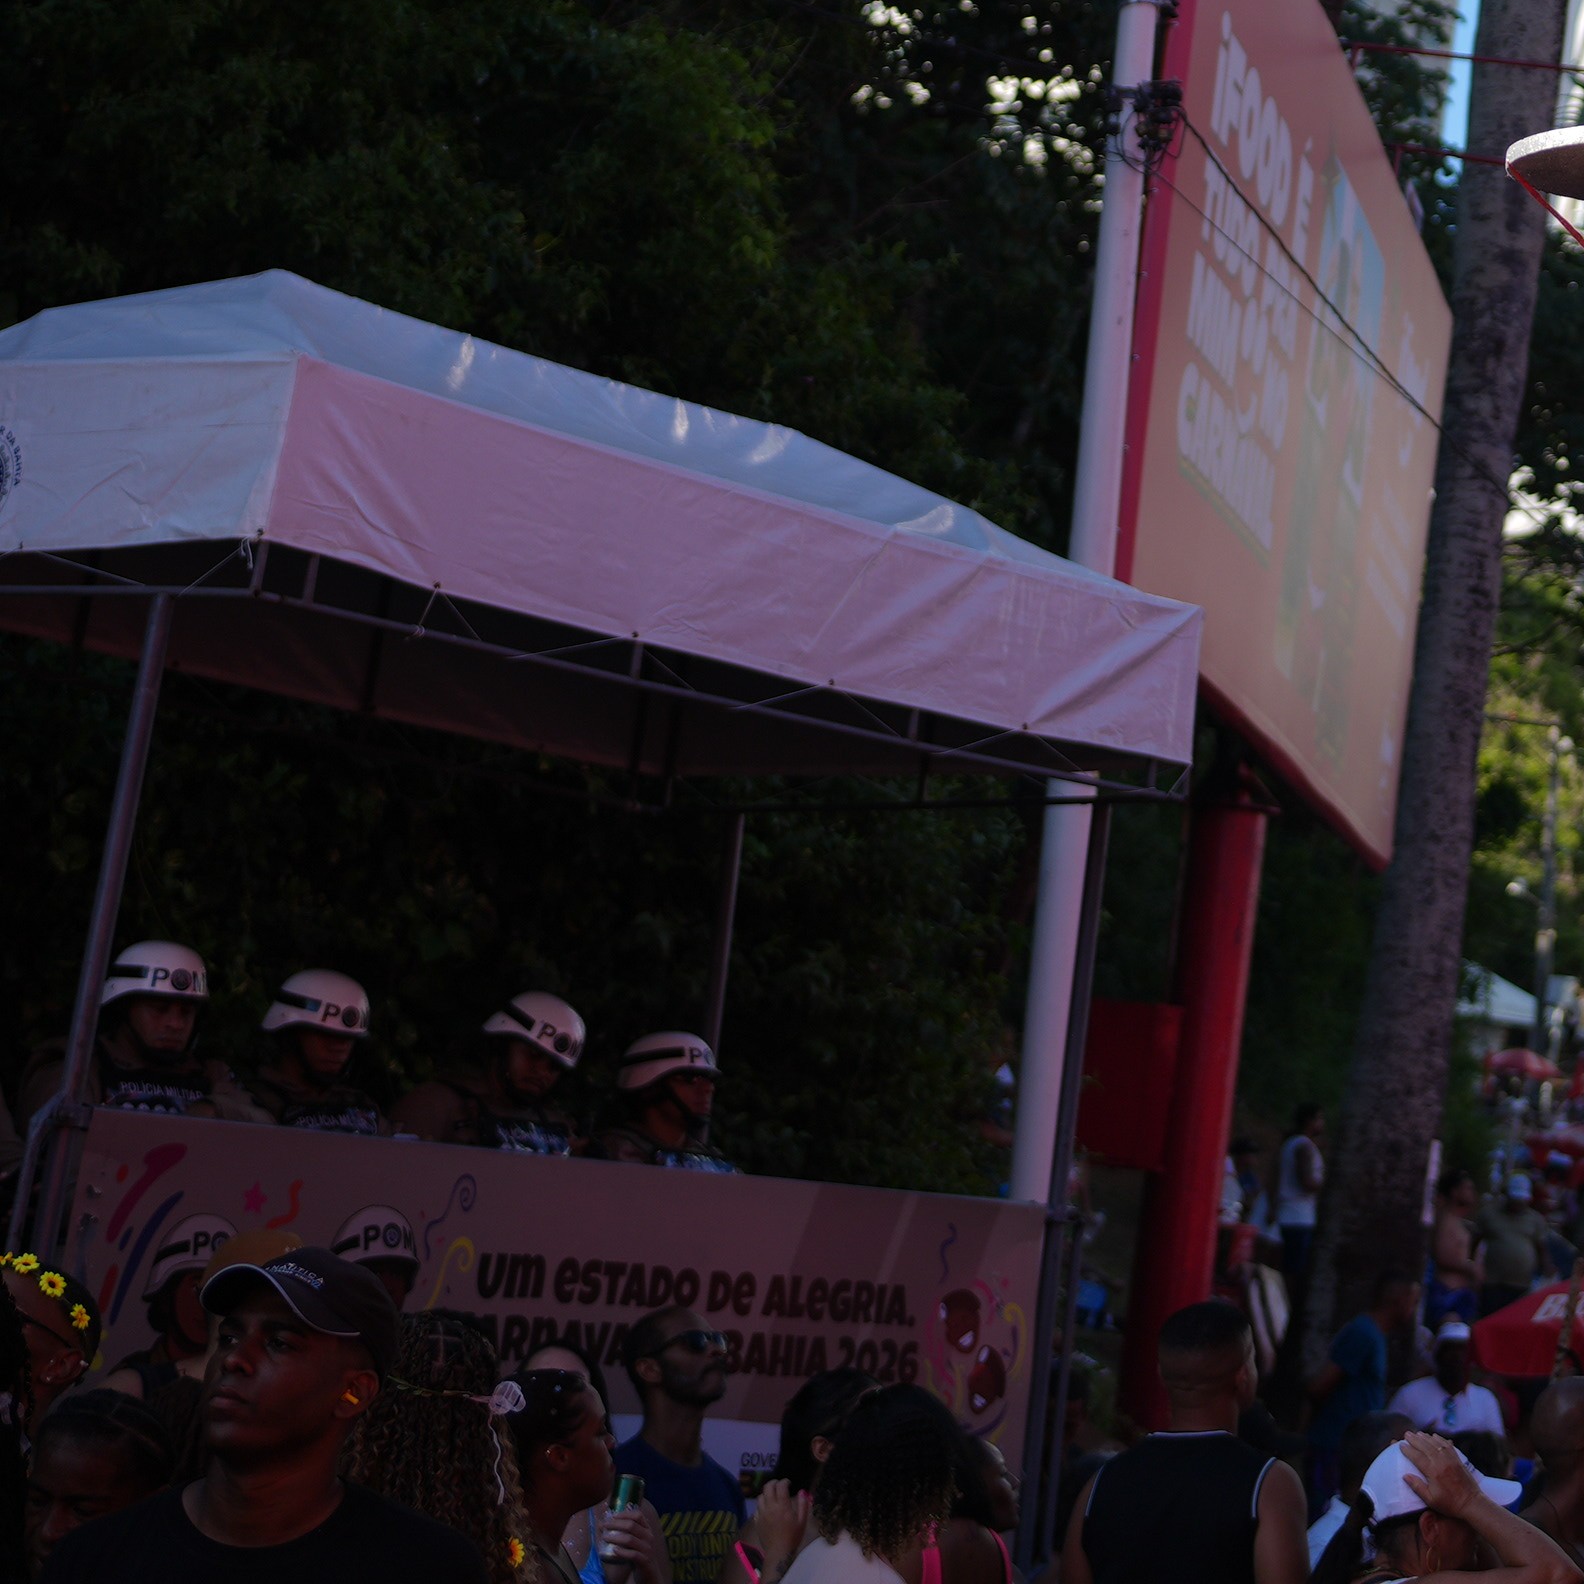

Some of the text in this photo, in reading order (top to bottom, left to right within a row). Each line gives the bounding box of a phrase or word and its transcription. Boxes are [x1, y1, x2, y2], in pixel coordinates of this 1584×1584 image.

[553, 1256, 699, 1308] ESTADO
[706, 1270, 758, 1316] DE
[761, 1273, 917, 1327] ALEGRIA.
[838, 1336, 919, 1385] 2026
